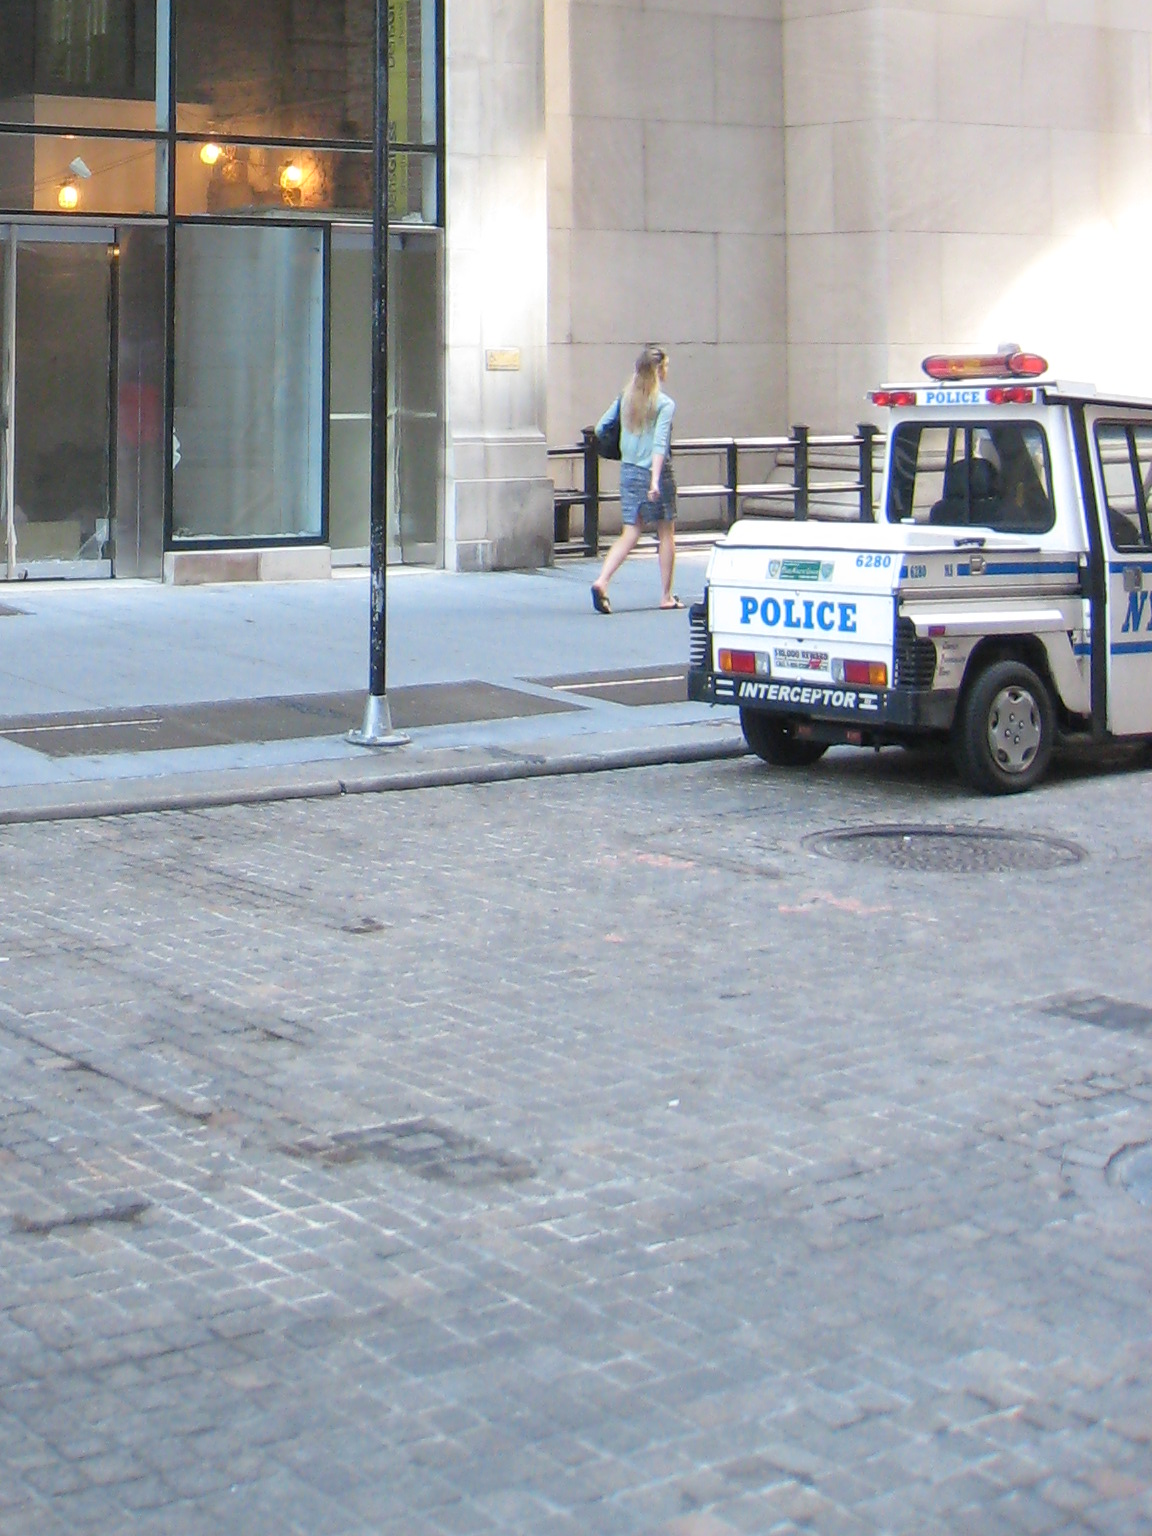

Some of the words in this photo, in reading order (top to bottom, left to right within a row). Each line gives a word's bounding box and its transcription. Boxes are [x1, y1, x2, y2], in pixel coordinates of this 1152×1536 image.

[926, 390, 980, 404] POLICE
[856, 555, 891, 568] 6280
[740, 596, 857, 633] POLICE
[739, 682, 857, 707] INTERCEPTOR
